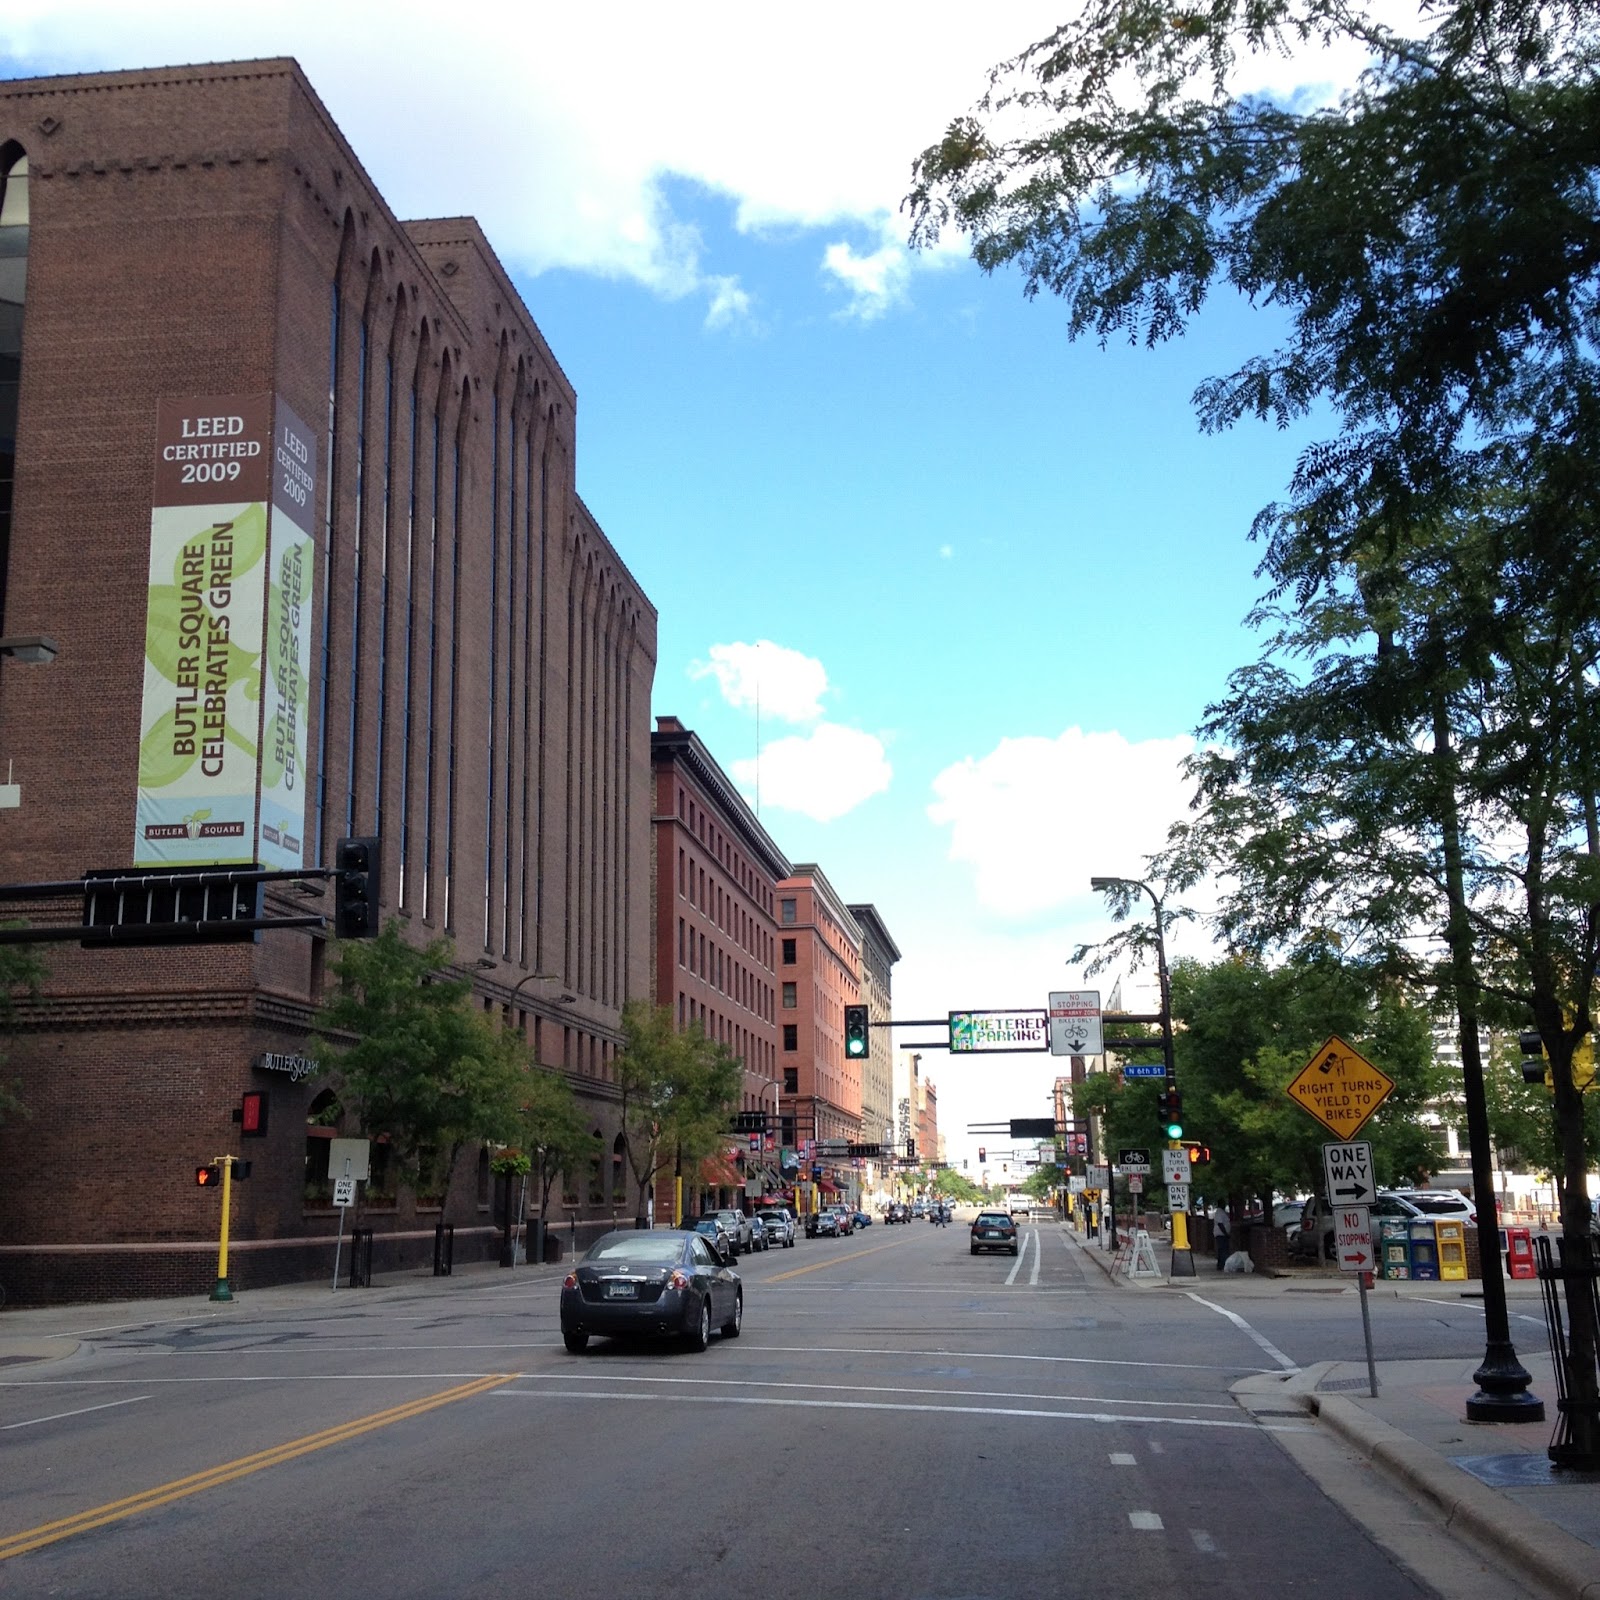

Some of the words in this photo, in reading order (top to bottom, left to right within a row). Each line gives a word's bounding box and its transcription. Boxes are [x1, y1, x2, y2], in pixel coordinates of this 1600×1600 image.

[181, 416, 244, 438] LEED
[163, 441, 261, 461] CERTIFIED
[284, 426, 308, 464] LEED
[181, 461, 241, 484] 2009
[277, 446, 314, 492] CERTIFIED
[283, 473, 306, 507] 2009
[209, 522, 234, 609] GREEN
[291, 542, 304, 629] GREEN
[178, 544, 205, 650] SQUARE
[279, 554, 293, 661] SQUARE
[173, 656, 200, 756] BUTLER
[201, 615, 231, 777] CELEBRATES
[275, 664, 288, 765] BUTLER
[285, 632, 300, 791] CELEBRATES
[148, 827, 184, 836] BUTLER
[204, 825, 242, 835] SQUARE
[1057, 1000, 1093, 1008] STOPPING
[973, 1018, 1046, 1030] METERED
[976, 1030, 1041, 1042] PARKING
[1128, 1067, 1135, 1075] N
[1136, 1067, 1151, 1075] 6th
[1152, 1067, 1161, 1075] St
[1299, 1083, 1335, 1094] RIGHT
[1342, 1080, 1383, 1092] TURNS
[1314, 1096, 1350, 1107] YIELD
[1355, 1094, 1371, 1105] TO
[1326, 1108, 1362, 1120] BIKES
[1330, 1147, 1366, 1163] ONE
[1331, 1165, 1367, 1180] WAY
[1344, 1213, 1359, 1228] NO
[1338, 1232, 1370, 1246] STOPPING
